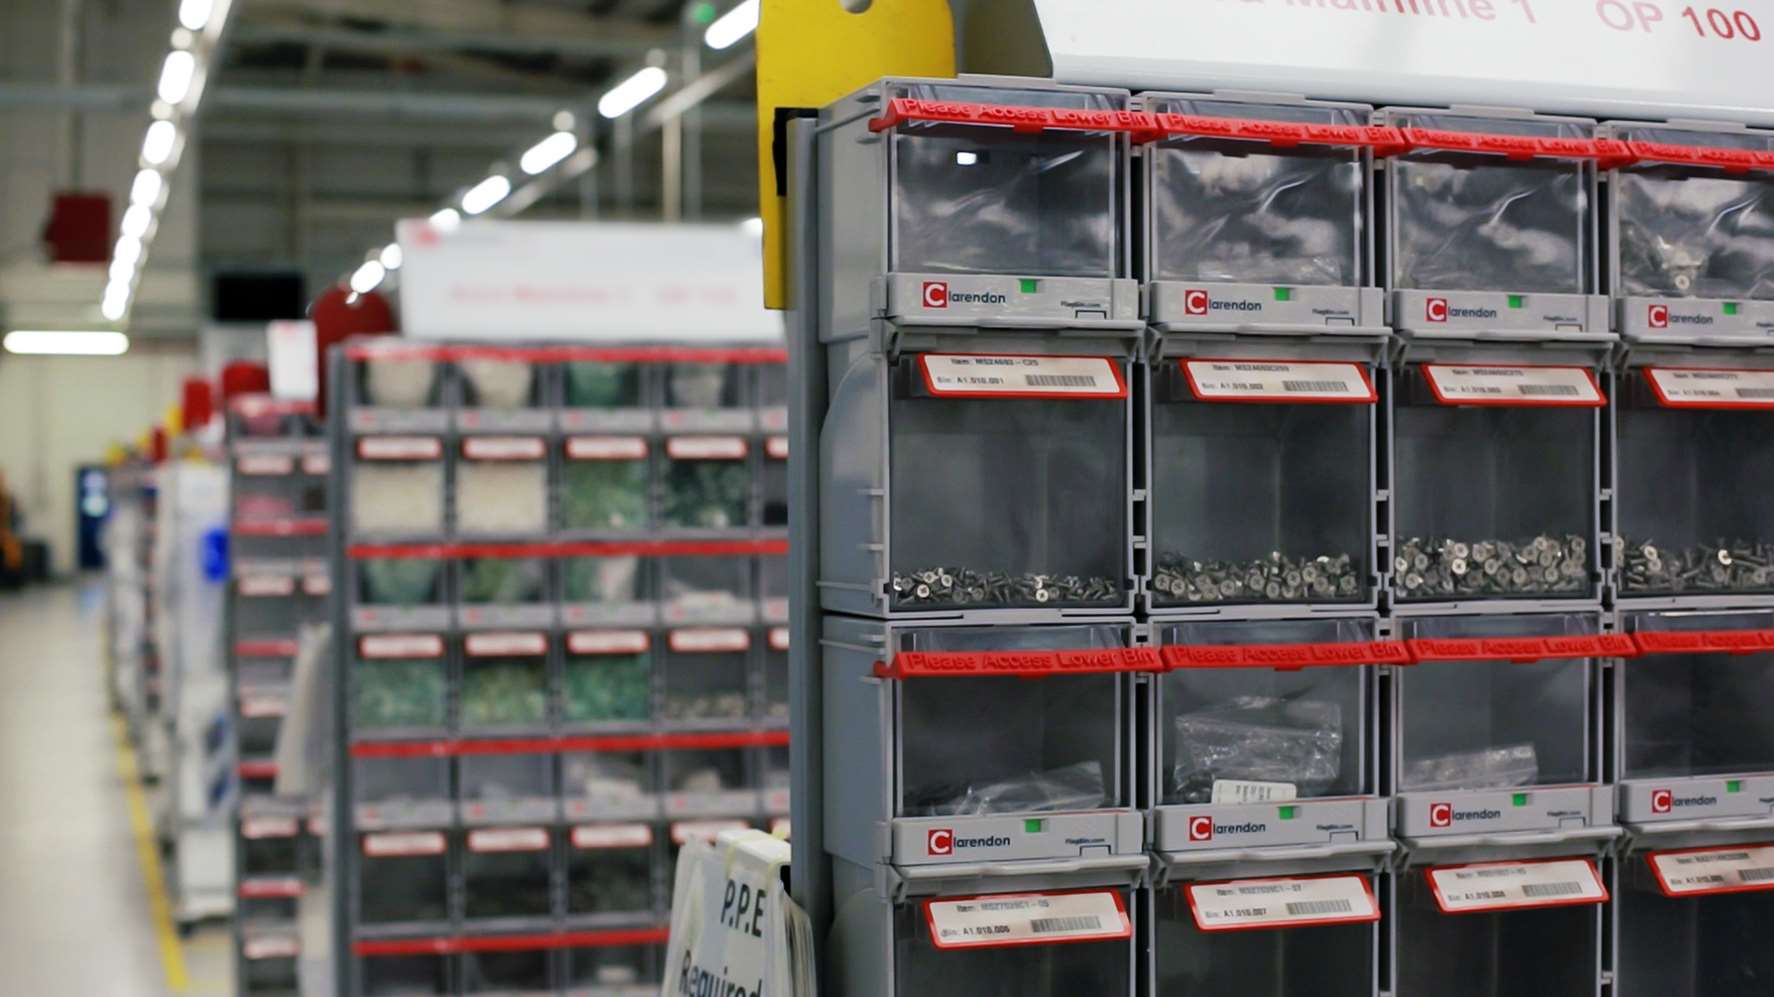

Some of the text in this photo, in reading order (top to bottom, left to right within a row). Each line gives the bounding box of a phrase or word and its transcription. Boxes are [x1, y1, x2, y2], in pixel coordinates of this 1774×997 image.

[1286, 0, 1497, 21] nline
[1595, 0, 1663, 33] OP
[1682, 6, 1761, 42] 100
[903, 98, 1150, 128] Please Access Lower Bin
[1168, 113, 1396, 145] Please Access Lower Bin
[924, 282, 1006, 307] Clarendon
[1186, 290, 1262, 315] Clarendon
[1427, 298, 1497, 322] Clarendon
[906, 648, 1154, 672] Please Access Lower Bin
[1172, 642, 1400, 664] Please Access Lower Bin
[1430, 803, 1500, 827] Clarendon
[1189, 816, 1266, 841] Clarendon
[928, 829, 1011, 855] Clarendon
[720, 879, 767, 938] P.P.E
